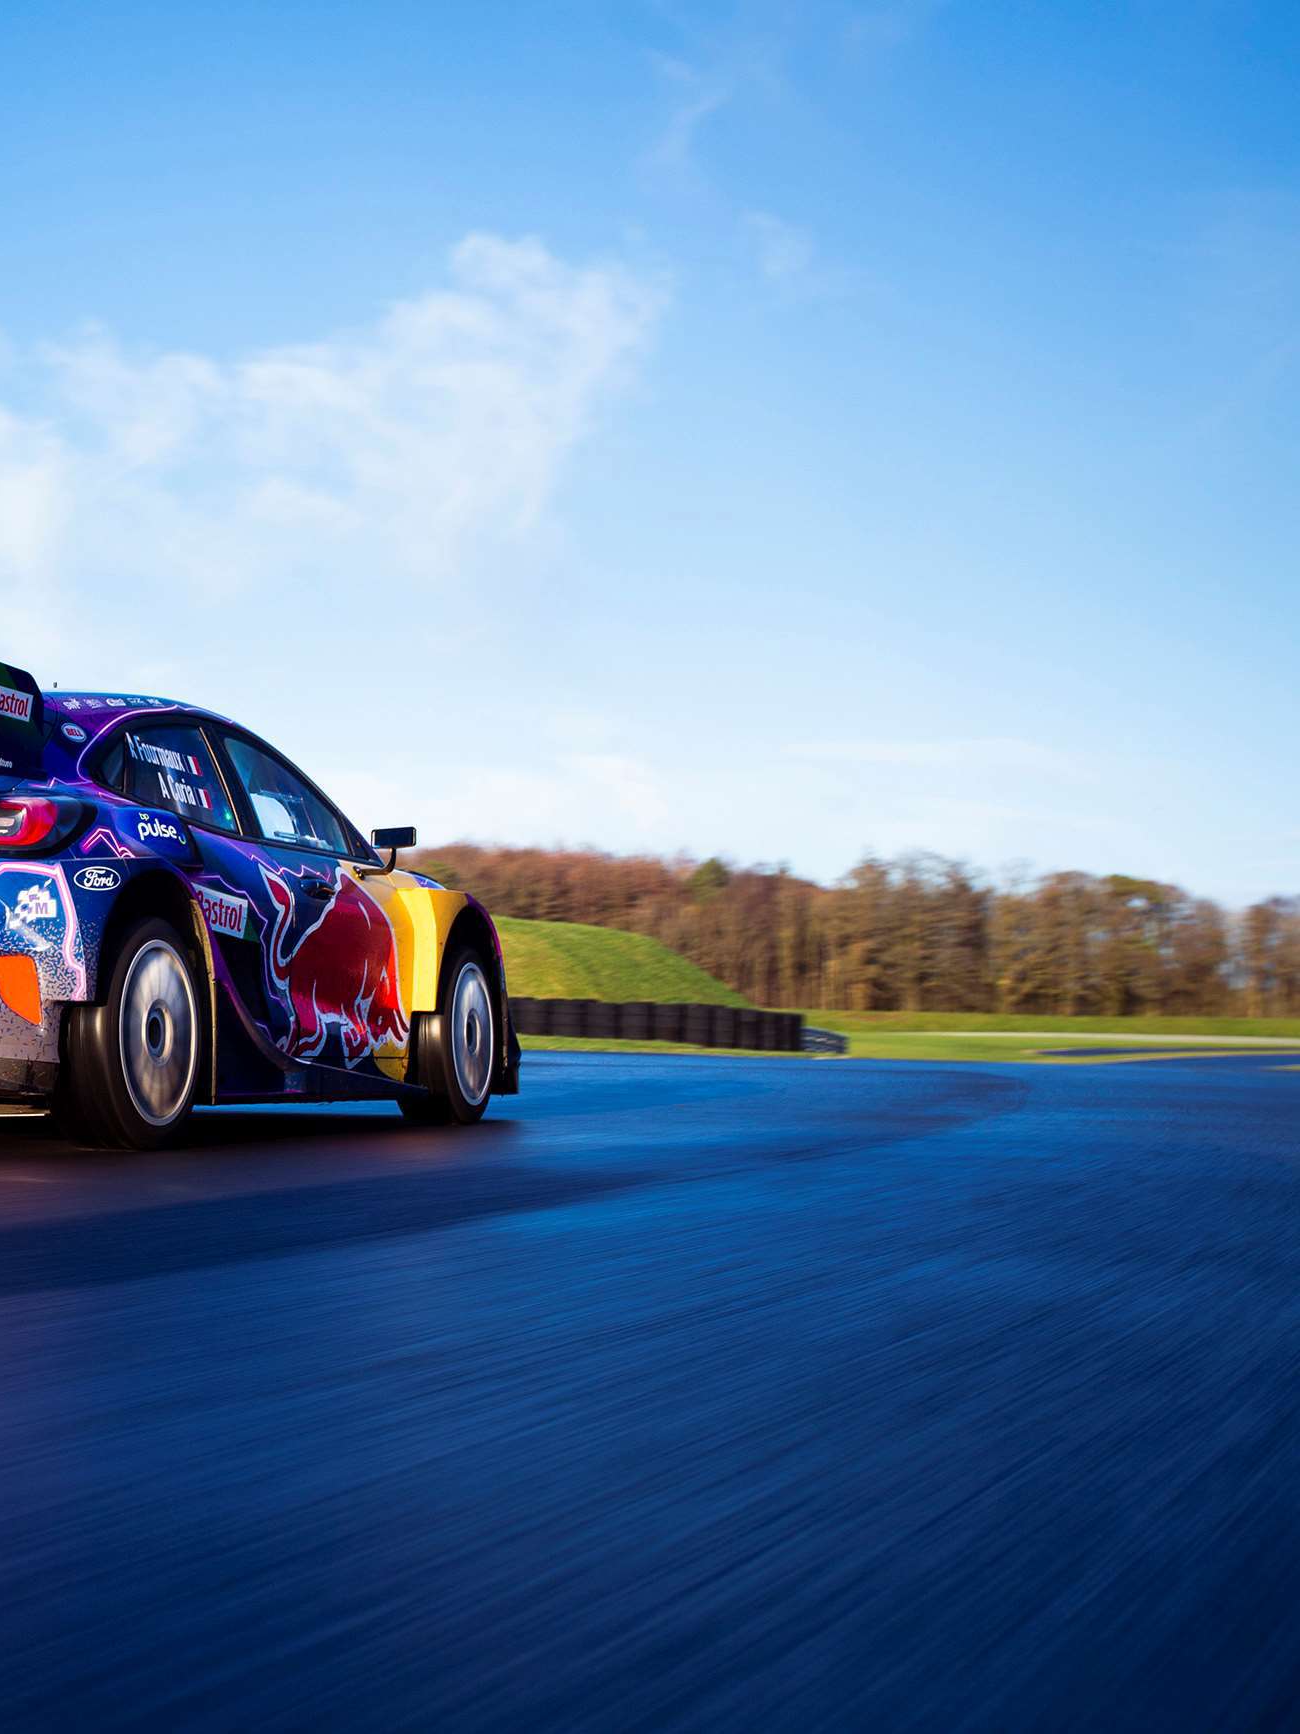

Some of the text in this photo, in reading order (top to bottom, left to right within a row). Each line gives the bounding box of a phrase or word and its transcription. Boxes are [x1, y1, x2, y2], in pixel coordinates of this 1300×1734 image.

[133, 735, 186, 772] Fourmaux
[157, 771, 197, 806] A Coria
[138, 812, 150, 822] bp
[137, 818, 178, 841] pulse
[83, 869, 115, 887] Ford
